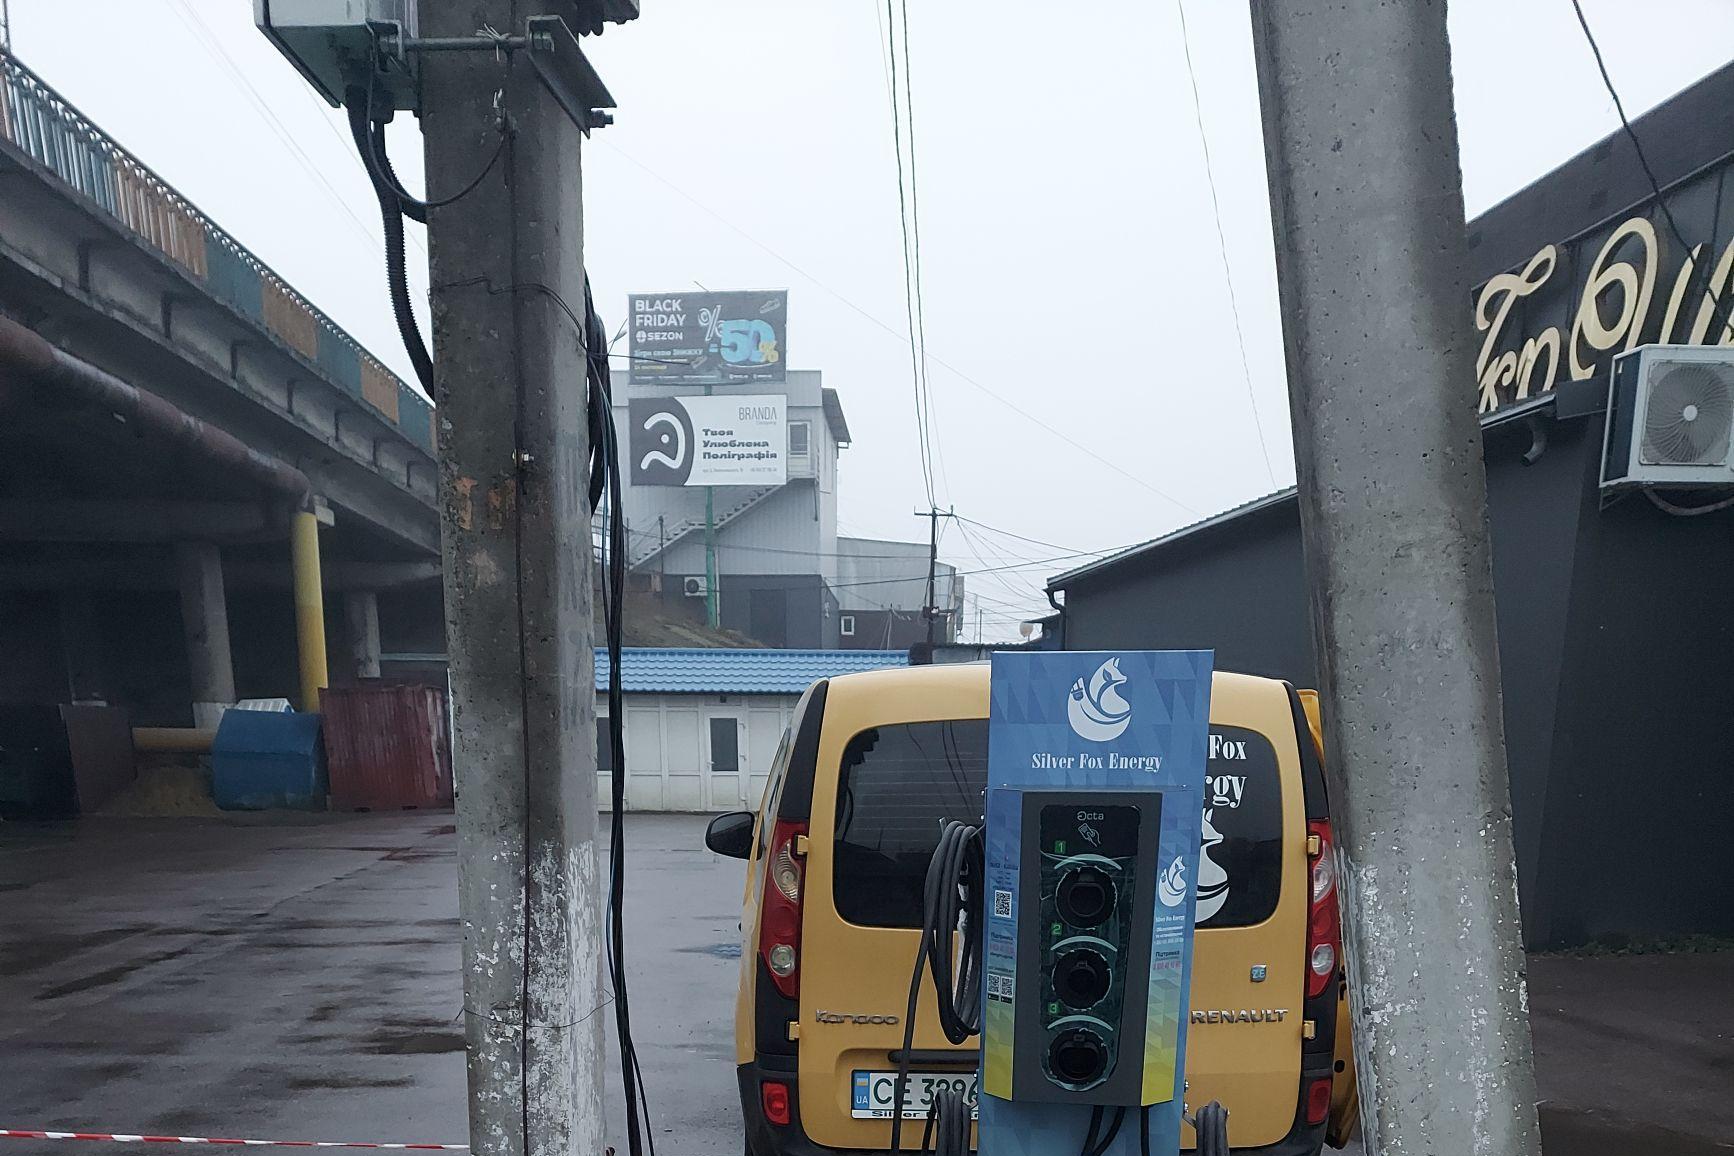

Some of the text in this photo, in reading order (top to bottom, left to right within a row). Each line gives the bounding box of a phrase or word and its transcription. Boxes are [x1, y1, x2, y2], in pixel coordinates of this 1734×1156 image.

[635, 299, 682, 312] BLACK
[635, 314, 687, 327] FRIDAY
[647, 332, 683, 341] SEZON
[738, 407, 777, 421] BRANDA
[702, 428, 734, 437] Твоя
[702, 439, 769, 448] Улюблена
[702, 450, 778, 461] Поліграфія
[1208, 734, 1247, 760] Fox
[1031, 752, 1162, 773] Silver Fox Energy
[1190, 1009, 1289, 1024] RENAULT
[856, 1095, 869, 1105] UA
[871, 1110, 920, 1118] Siler
